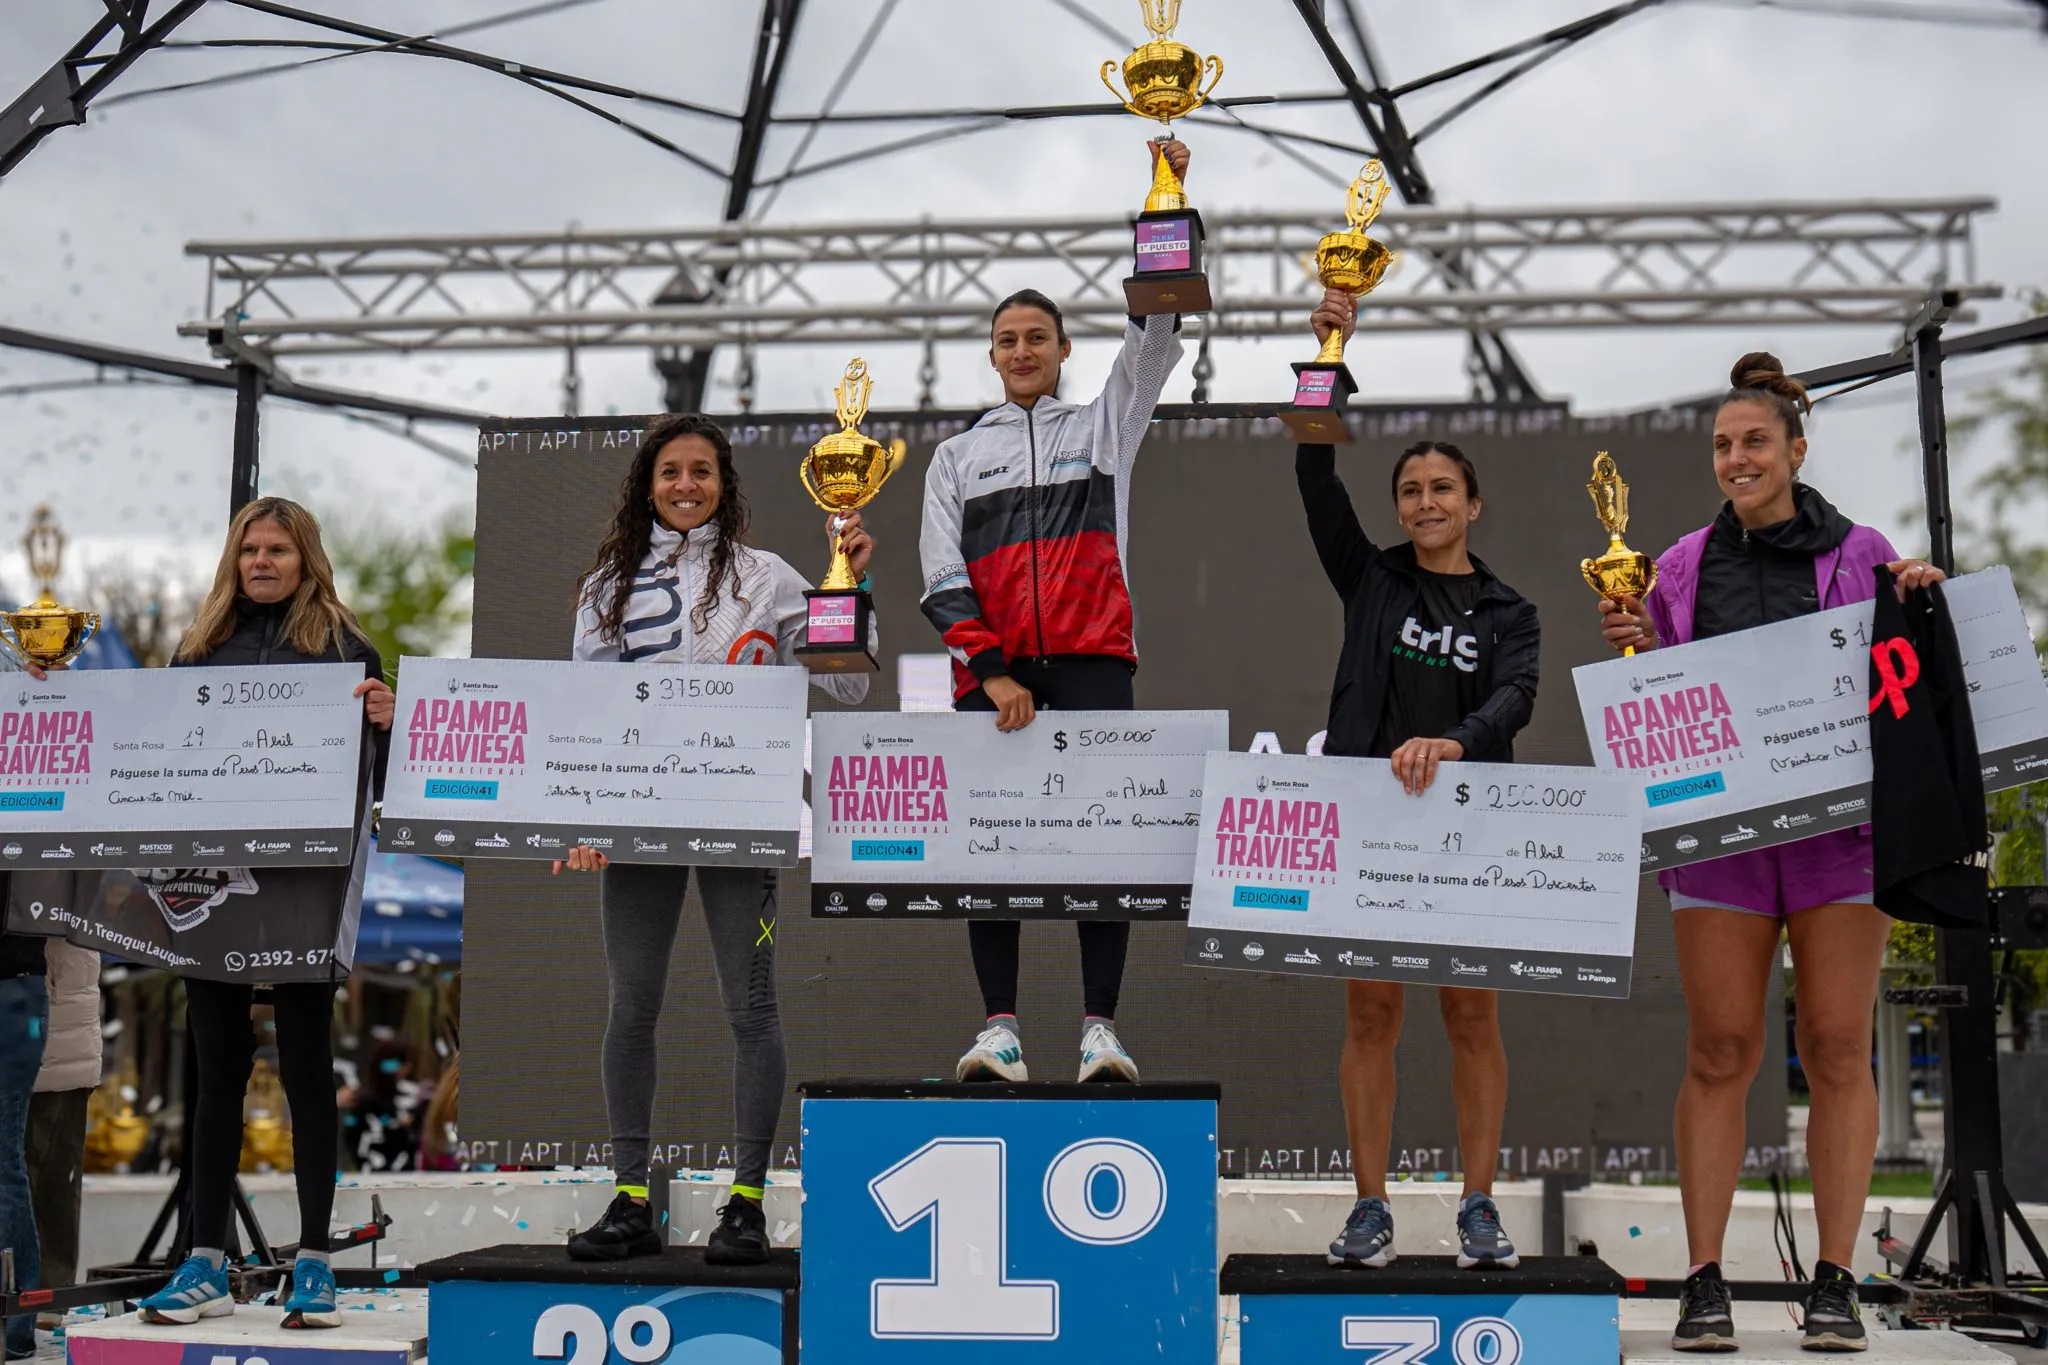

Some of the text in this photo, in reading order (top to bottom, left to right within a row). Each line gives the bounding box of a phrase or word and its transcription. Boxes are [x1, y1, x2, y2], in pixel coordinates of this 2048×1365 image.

[1150, 242, 1187, 251] PUESTO
[478, 432, 519, 451] APT
[540, 431, 580, 450] APT
[602, 429, 643, 449] APT
[1830, 628, 1847, 650] $
[1392, 645, 1448, 668] NNING
[1645, 675, 1666, 684] Santa
[1667, 671, 1685, 679] Rosa
[1756, 645, 2017, 717] Santa Rosa 19 2026
[197, 684, 210, 706] $
[636, 678, 734, 702] $ 375.000
[409, 699, 528, 734] APAMPA
[1603, 682, 1733, 742] APAMPA
[0, 711, 94, 745] PAMPA
[549, 735, 577, 744] Santa
[578, 736, 602, 745] Rosa
[622, 728, 640, 745] 19
[684, 738, 696, 747] de
[766, 740, 791, 749] 2026
[1764, 725, 1820, 746] Páguese
[1823, 722, 1836, 731] la
[113, 743, 139, 751] Santa
[142, 742, 164, 750] Rosa
[242, 739, 254, 748] de
[321, 738, 346, 746] 2026
[408, 732, 525, 764] TRAVIESA
[1053, 730, 1068, 752] $
[1607, 717, 1741, 769] TRAVIESA
[0, 745, 91, 775] RAVIESA
[403, 764, 525, 776] INTERNACIONAL
[546, 761, 598, 775] Páguese
[602, 762, 612, 772] la
[616, 765, 649, 774] suma
[652, 763, 668, 774] de
[1651, 753, 1745, 779] RNACIONAL
[2026, 758, 2048, 769] Pamp
[110, 768, 160, 780] Páguese
[163, 768, 175, 777] la
[212, 767, 227, 777] de
[829, 755, 948, 790] APAMPA
[969, 789, 997, 798] Santa
[1000, 789, 1024, 798] Rosa
[1041, 772, 1064, 795] 19
[1106, 789, 1119, 798] de
[1189, 789, 1203, 798] 20
[1455, 782, 1470, 806] $
[828, 791, 948, 822] TRAVIESA
[969, 817, 1093, 830] Páguese la suma de
[1216, 797, 1340, 839] APAMPA
[828, 825, 948, 834] INTERNACIONAL
[314, 846, 338, 854] Pampa
[701, 841, 737, 850] LA PAMPA
[760, 847, 786, 856] Pampa
[1216, 833, 1337, 872] TRAVIESA
[1361, 840, 1391, 850] Santa
[1393, 842, 1419, 852] Rosa
[1441, 832, 1462, 852] 19
[1506, 848, 1520, 858] de
[1596, 852, 1624, 863] 2026
[164, 882, 216, 894] DEPORTIVOS
[1211, 870, 1336, 885] INTERNACIONAL
[1359, 869, 1414, 884] Páguese
[1418, 872, 1430, 884] la
[1433, 876, 1468, 887] suma
[1472, 876, 1489, 887] de
[95, 923, 145, 951] Trenque
[249, 950, 293, 967] 2392
[1200, 952, 1223, 960] CHALTEN
[1524, 965, 1563, 975] LA PAMPA
[1589, 975, 1617, 984] Pampa
[456, 1141, 498, 1161] APT
[520, 1143, 563, 1162] APT
[585, 1143, 613, 1164] AP
[650, 1144, 694, 1164] APT
[1260, 1150, 1304, 1169] APT
[1397, 1149, 1444, 1169] APT
[1536, 1148, 1582, 1169] APT
[1605, 1147, 1652, 1169] APT
